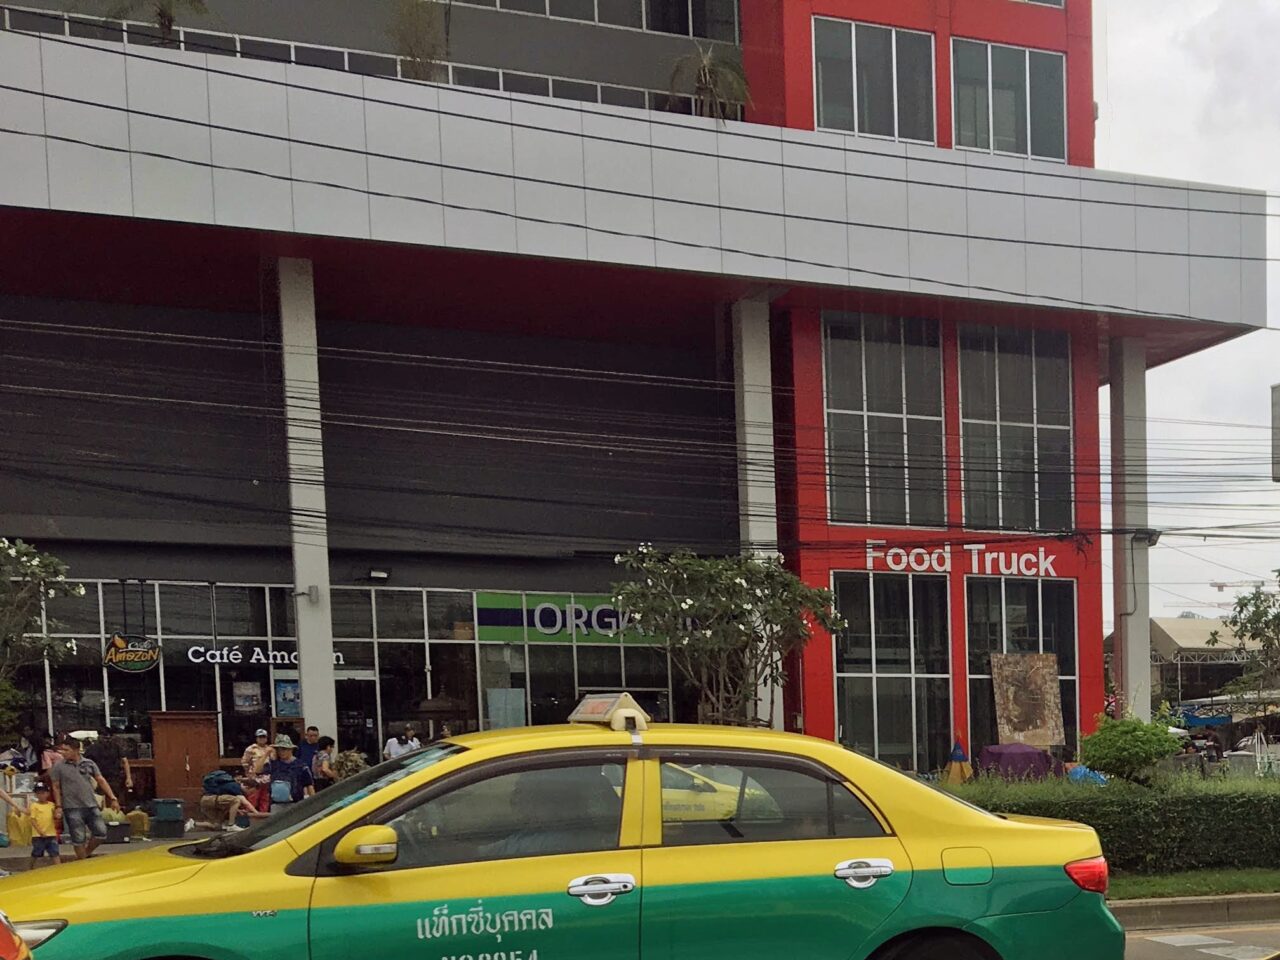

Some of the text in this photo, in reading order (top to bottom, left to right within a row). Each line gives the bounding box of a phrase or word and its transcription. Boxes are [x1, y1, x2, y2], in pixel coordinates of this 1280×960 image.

[866, 539, 1058, 577] Food Truck
[188, 645, 345, 665] Café Aman
[416, 899, 553, 942] แท็กซี่บุคคล
